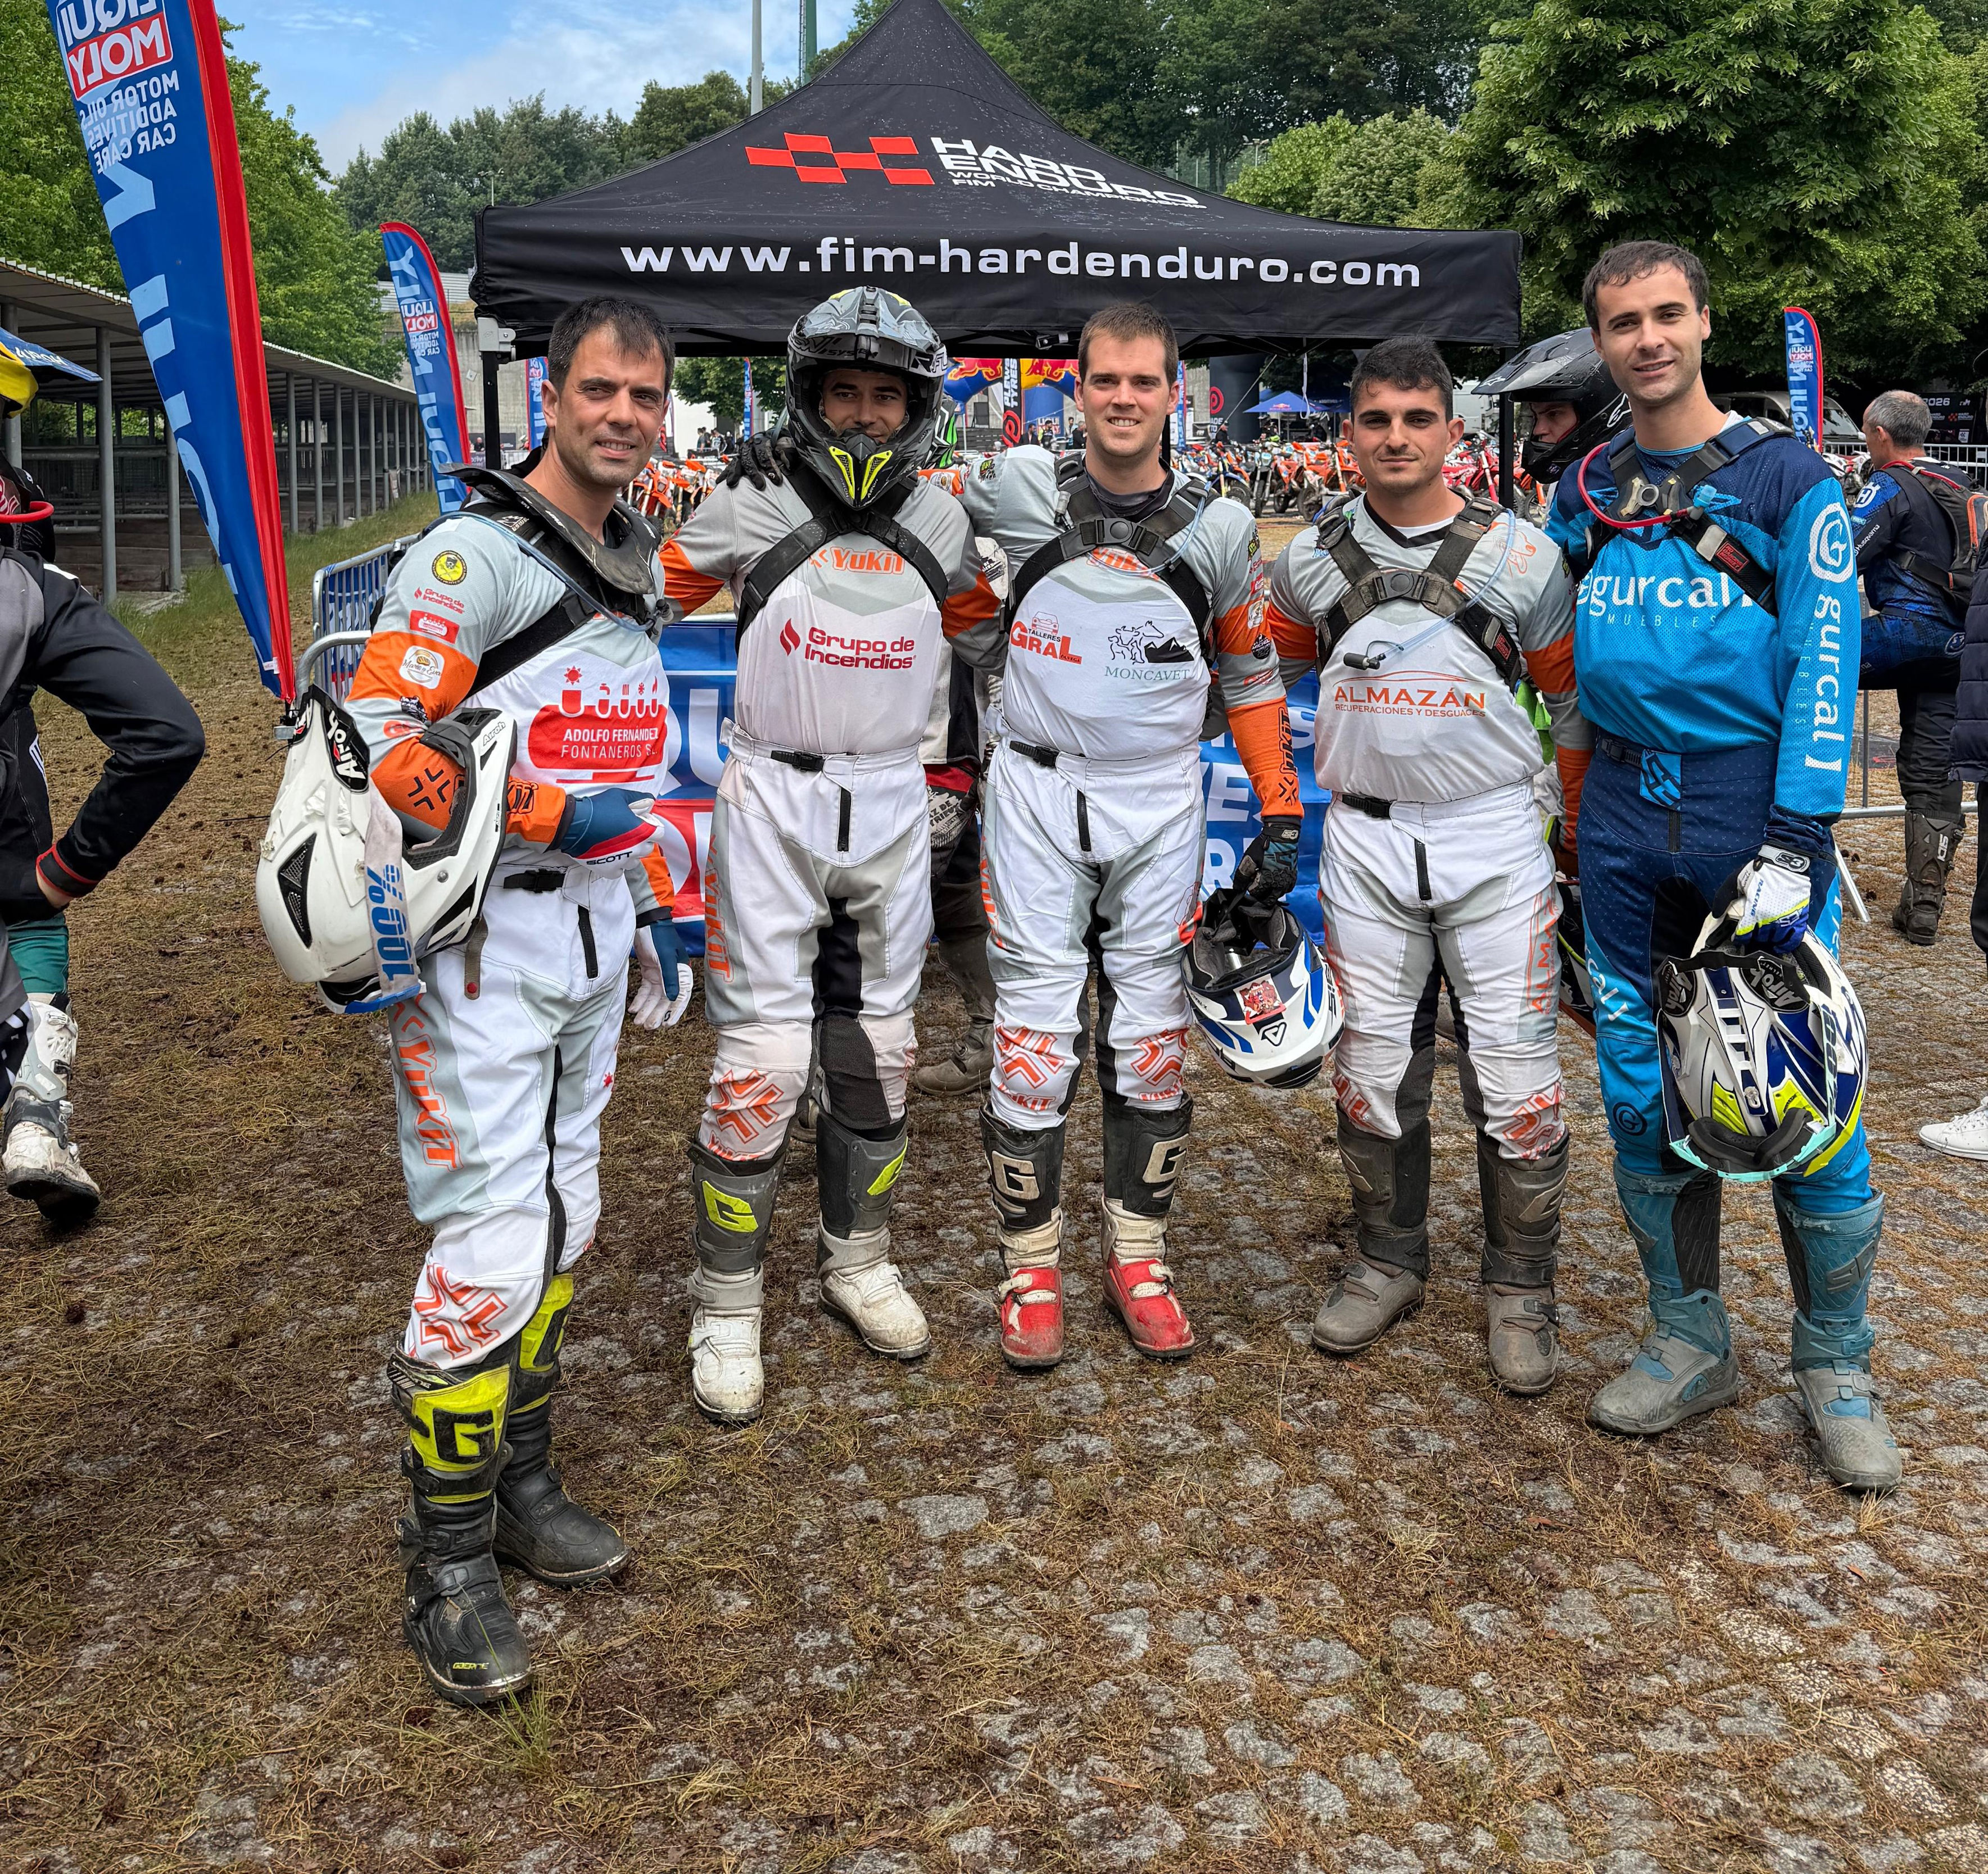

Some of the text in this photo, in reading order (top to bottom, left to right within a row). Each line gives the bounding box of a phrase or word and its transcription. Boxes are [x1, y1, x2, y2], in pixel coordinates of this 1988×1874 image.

[930, 137, 1106, 181] HARD
[938, 153, 1199, 205] ENDURO
[948, 171, 1208, 210] WORLD CHAMPIONSHIP
[952, 179, 996, 188] FIM
[620, 236, 1421, 288] www.fim-hardenduro.com
[1010, 358, 1018, 409] TYRES
[1857, 524, 1881, 552] Husqvarna
[422, 594, 463, 614] Incendios
[424, 588, 464, 609] Grupo de
[1607, 614, 1716, 628] MUEBLES
[807, 627, 916, 656] Grupo de
[1027, 628, 1061, 642] TALLERES
[804, 645, 914, 670] Incendios
[1813, 593, 1845, 742] gurcal
[1104, 666, 1190, 681] MONCAVET
[1334, 686, 1486, 710] ALMAZÁN
[1335, 704, 1415, 716] RECUPERACIONES
[1424, 709, 1486, 718] DESGUACES
[563, 728, 610, 743] ADOLFO
[561, 744, 642, 759] FONTANEROS
[586, 851, 633, 865] SCOTT
[1750, 878, 1764, 917] RACING
[366, 864, 415, 982] 100%
